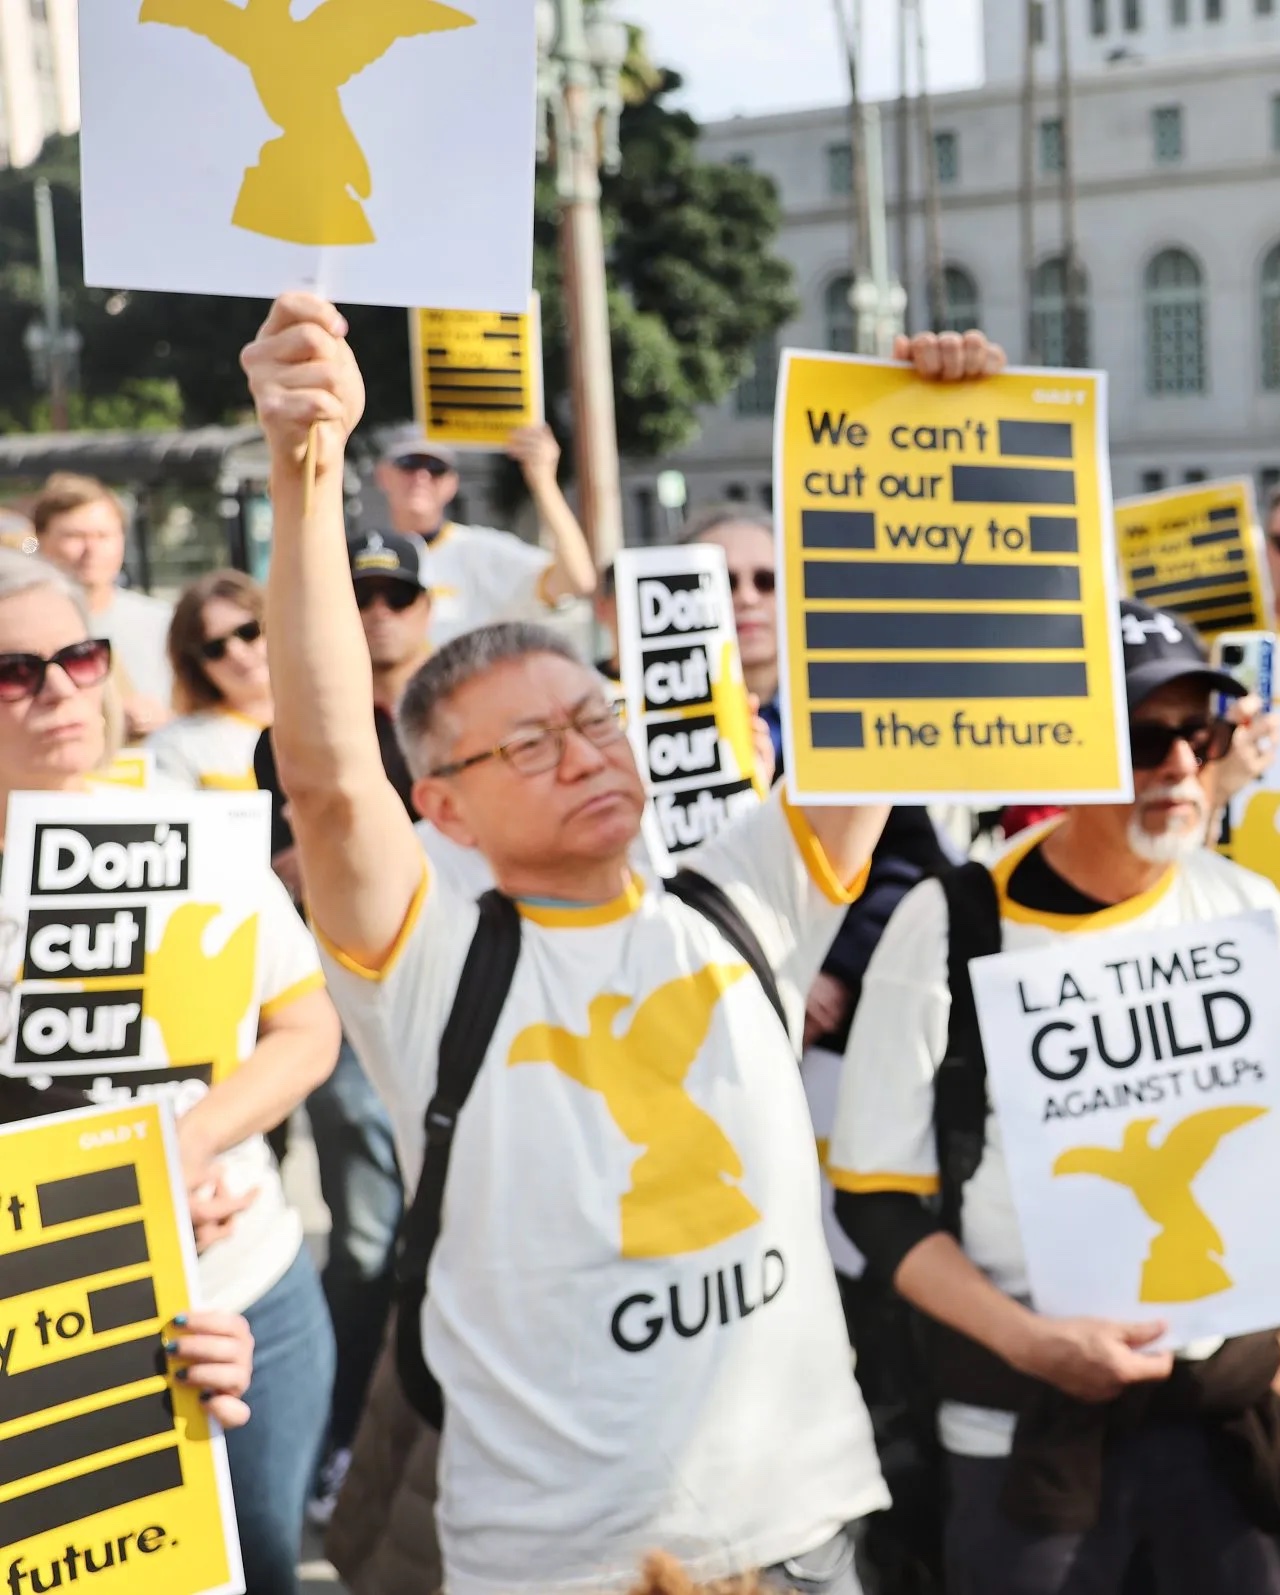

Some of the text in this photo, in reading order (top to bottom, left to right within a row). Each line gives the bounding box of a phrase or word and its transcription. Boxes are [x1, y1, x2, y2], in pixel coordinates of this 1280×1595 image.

[806, 408, 988, 454] We can't
[803, 464, 943, 501] cut our
[884, 519, 1026, 564] way to
[644, 647, 709, 705] cut
[649, 725, 718, 776] our
[874, 713, 1083, 748] the future.
[38, 822, 187, 891] Don't
[29, 909, 139, 973] cut
[1105, 941, 1241, 996] TIMES
[21, 1002, 141, 1056] our
[1031, 991, 1252, 1081] GUILD
[1042, 1057, 1266, 1123] AGAINST ULPs
[611, 1248, 786, 1352] GUILD
[34, 1310, 86, 1347] to
[7, 1525, 178, 1595] future.
